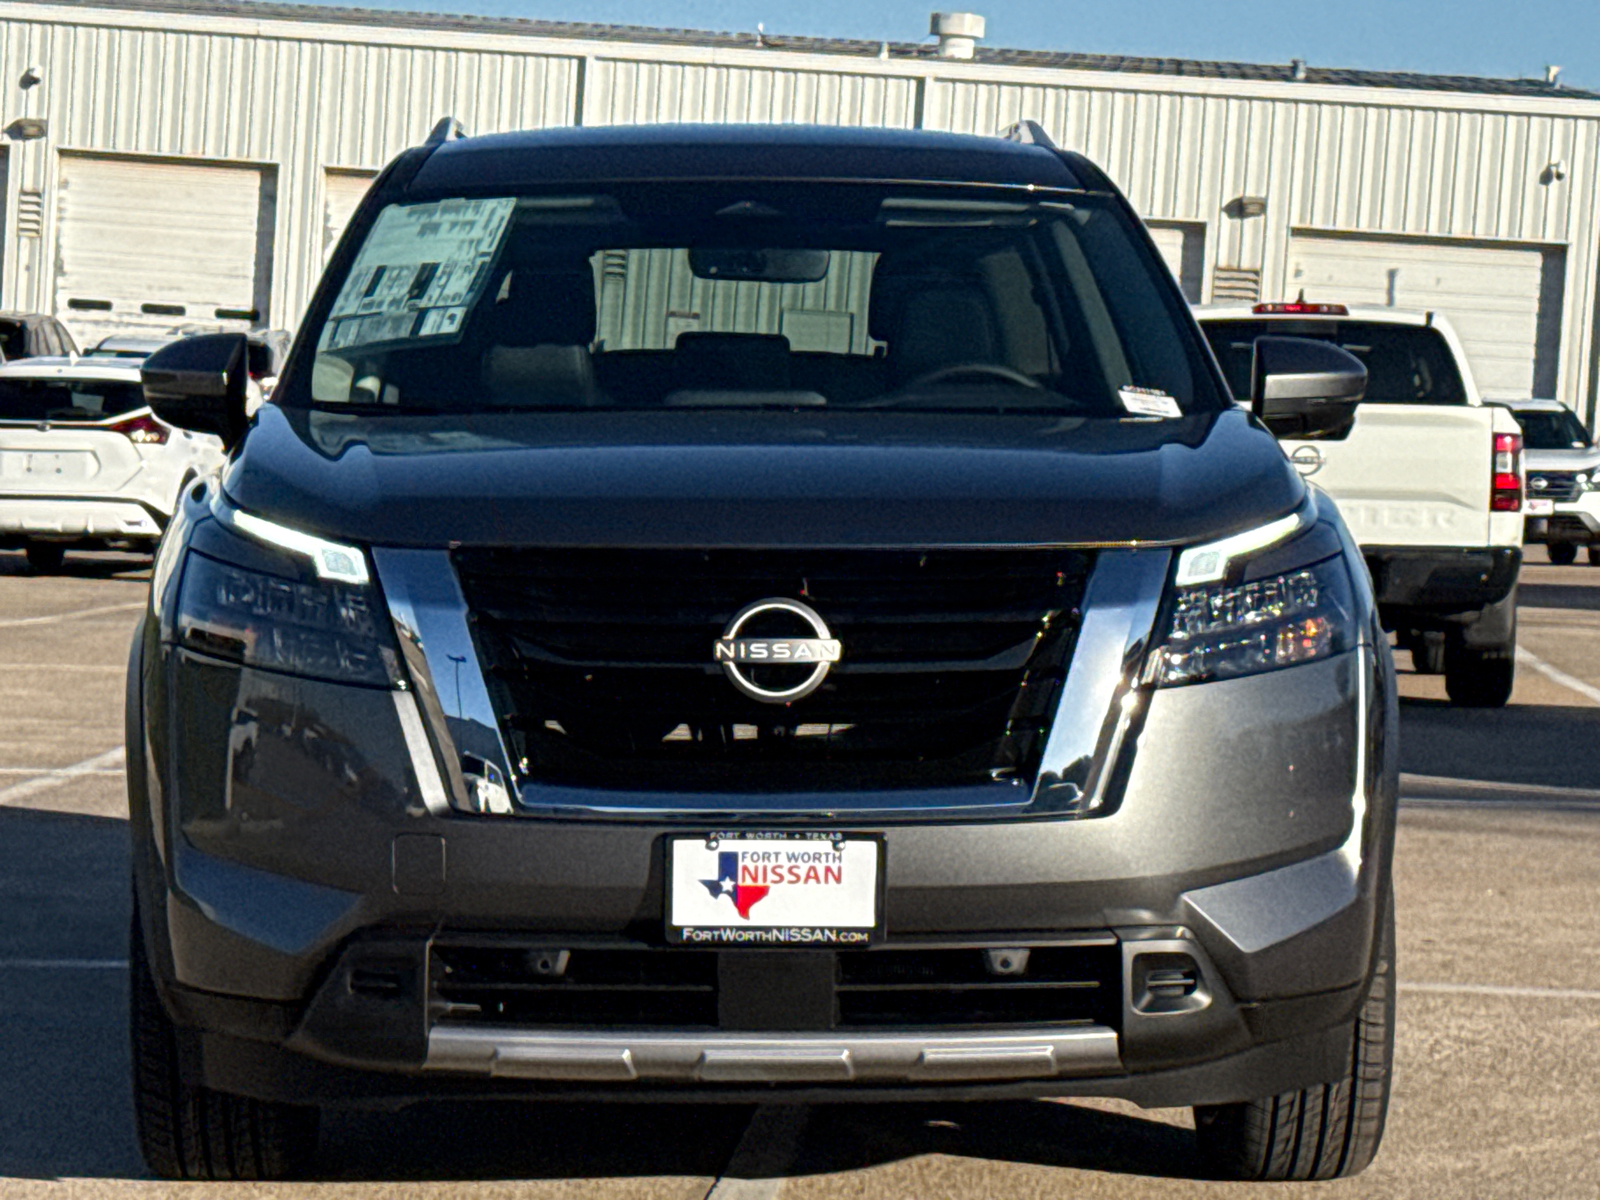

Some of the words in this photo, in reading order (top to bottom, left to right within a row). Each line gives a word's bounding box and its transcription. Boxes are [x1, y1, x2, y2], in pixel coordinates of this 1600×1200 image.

[715, 642, 836, 659] NISSAN
[709, 832, 740, 840] FORT
[745, 832, 787, 840] WORTH
[805, 832, 843, 841] TEXAS
[741, 851, 781, 863] FORT
[786, 851, 843, 864] WORTH
[741, 865, 843, 885] NISSAN
